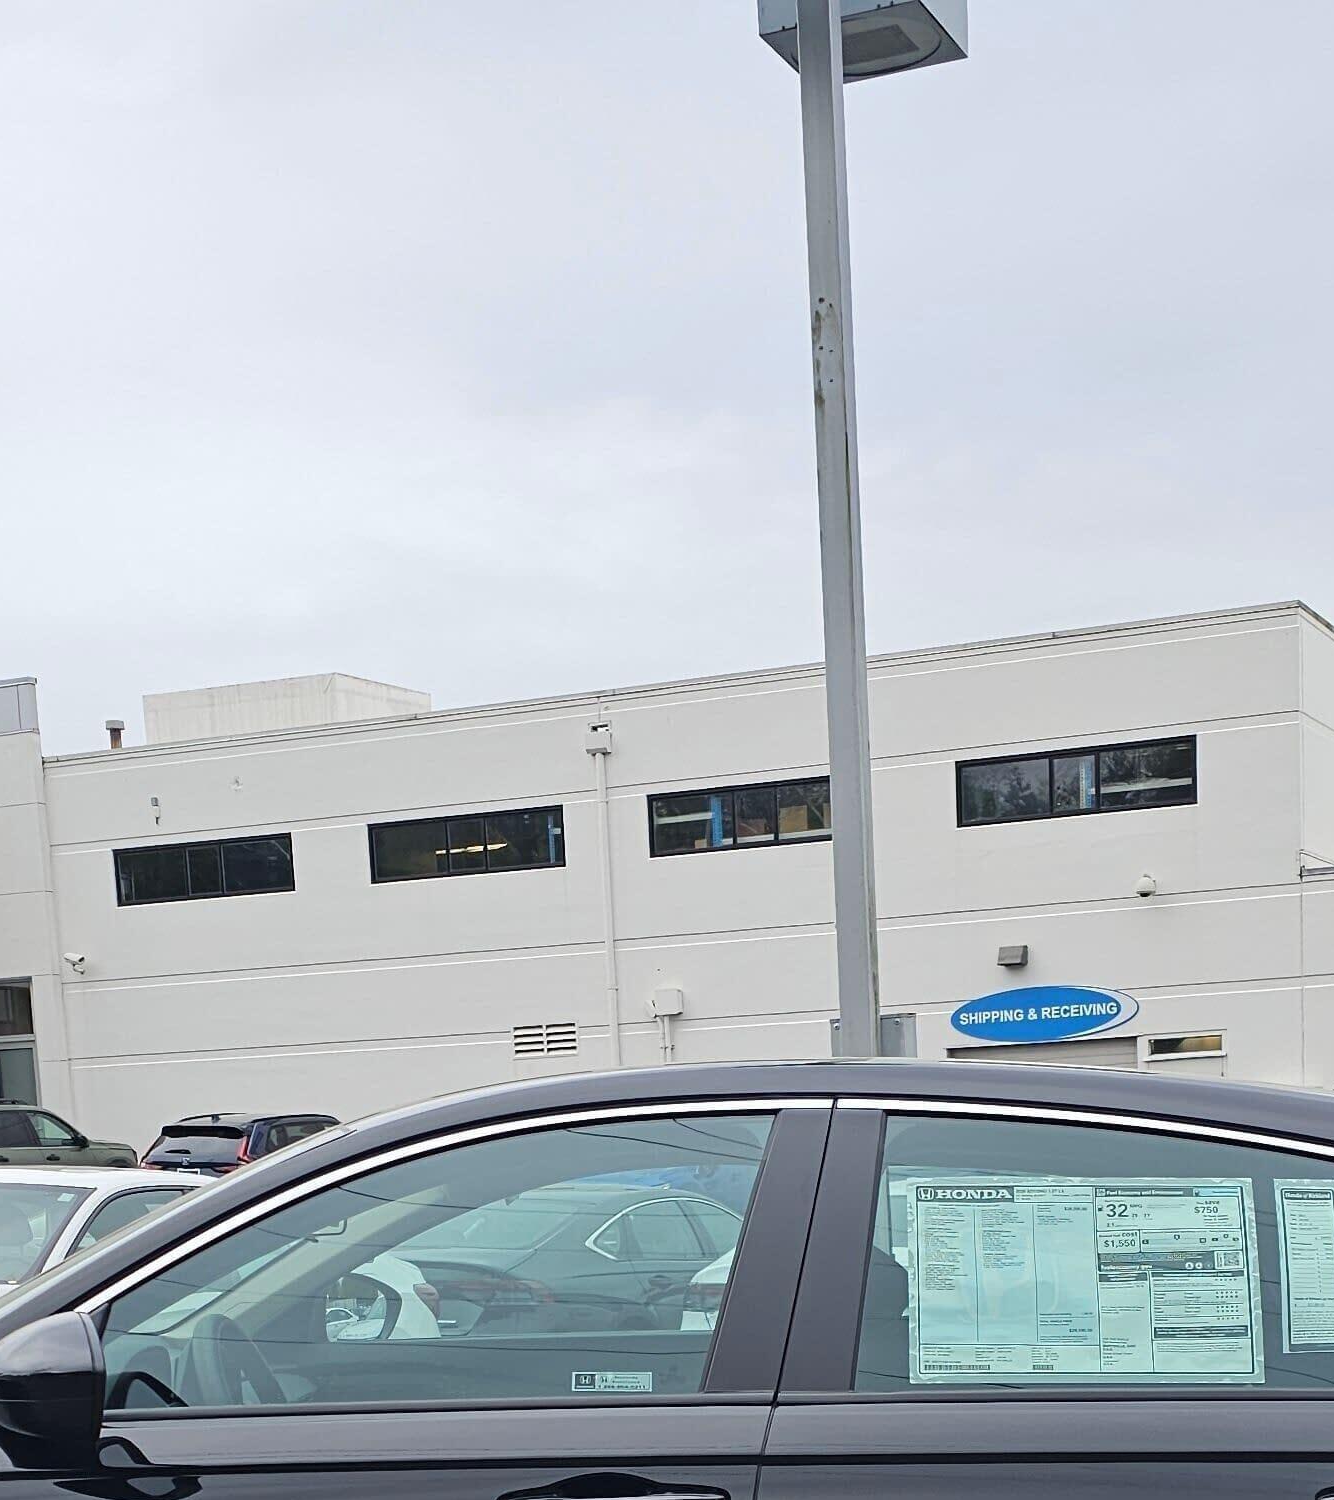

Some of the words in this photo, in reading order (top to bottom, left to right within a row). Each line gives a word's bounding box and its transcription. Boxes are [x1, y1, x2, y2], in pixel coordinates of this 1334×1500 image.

[959, 1009, 1024, 1026] SHIPPING
[1027, 1008, 1038, 1020] &
[1041, 1002, 1118, 1019] RECEIVING
[935, 1189, 1013, 1200] HONDA
[1106, 1203, 1129, 1218] 32
[1193, 1206, 1219, 1214] $750
[1103, 1239, 1136, 1249] $1,550
